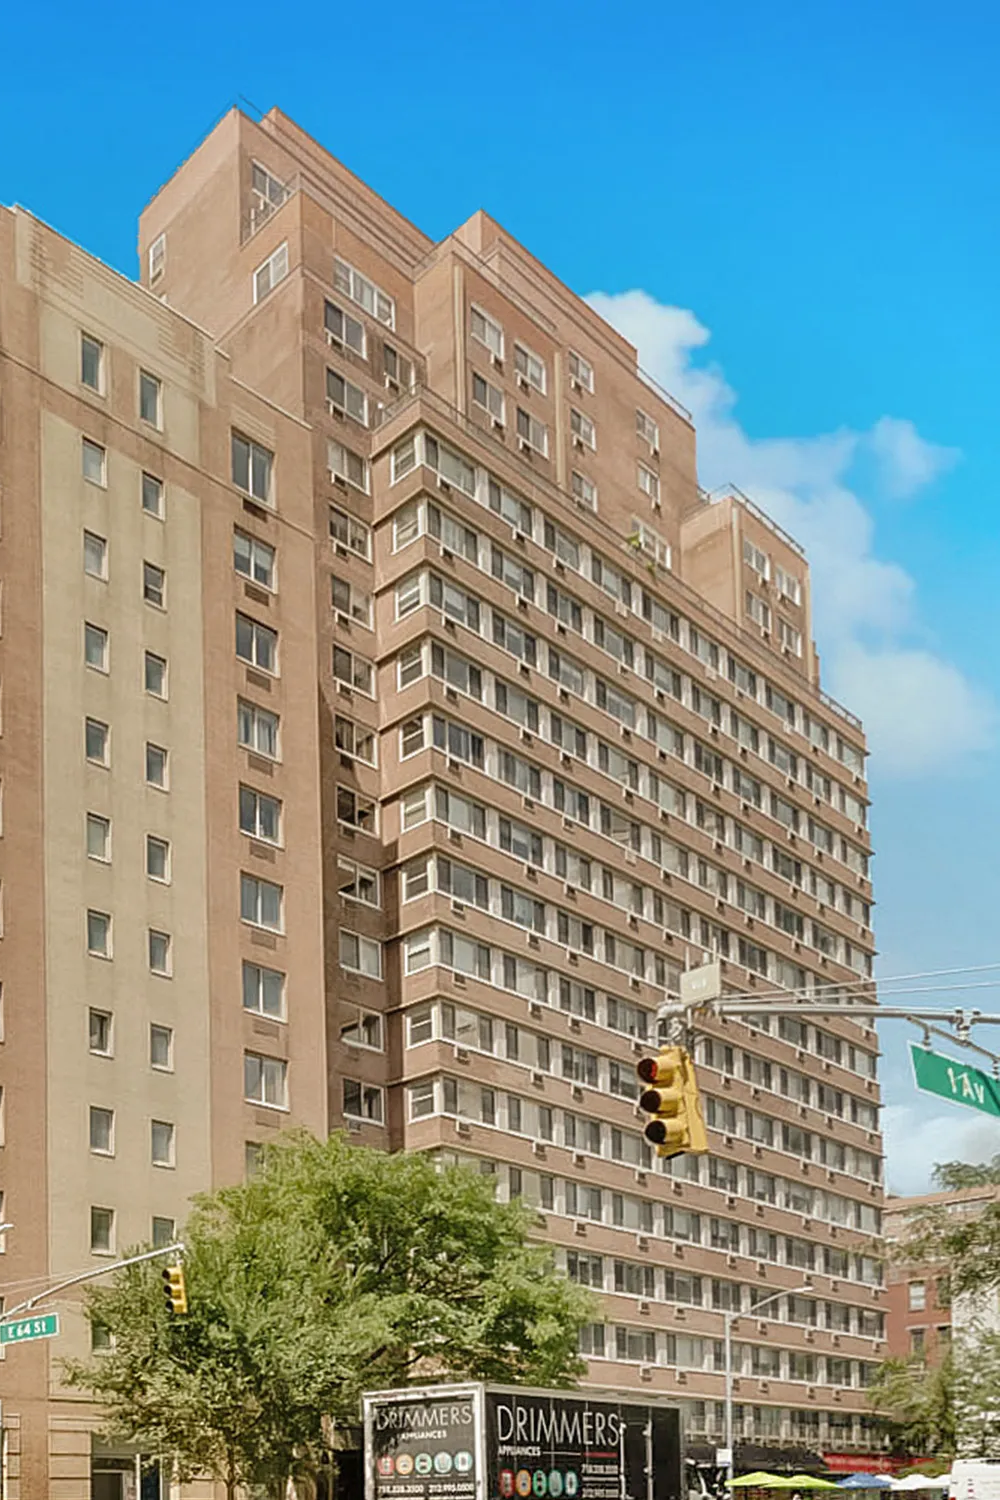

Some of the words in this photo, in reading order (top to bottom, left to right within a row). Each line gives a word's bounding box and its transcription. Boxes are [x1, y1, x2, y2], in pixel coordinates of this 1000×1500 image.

[961, 1072, 984, 1104] Av
[7, 1325, 16, 1339] E
[16, 1323, 32, 1337] 64
[33, 1320, 47, 1334] St
[376, 1405, 473, 1430] DRIMMERS
[497, 1405, 619, 1446] DRIMMERS
[498, 1445, 541, 1457] APPLIANCES
